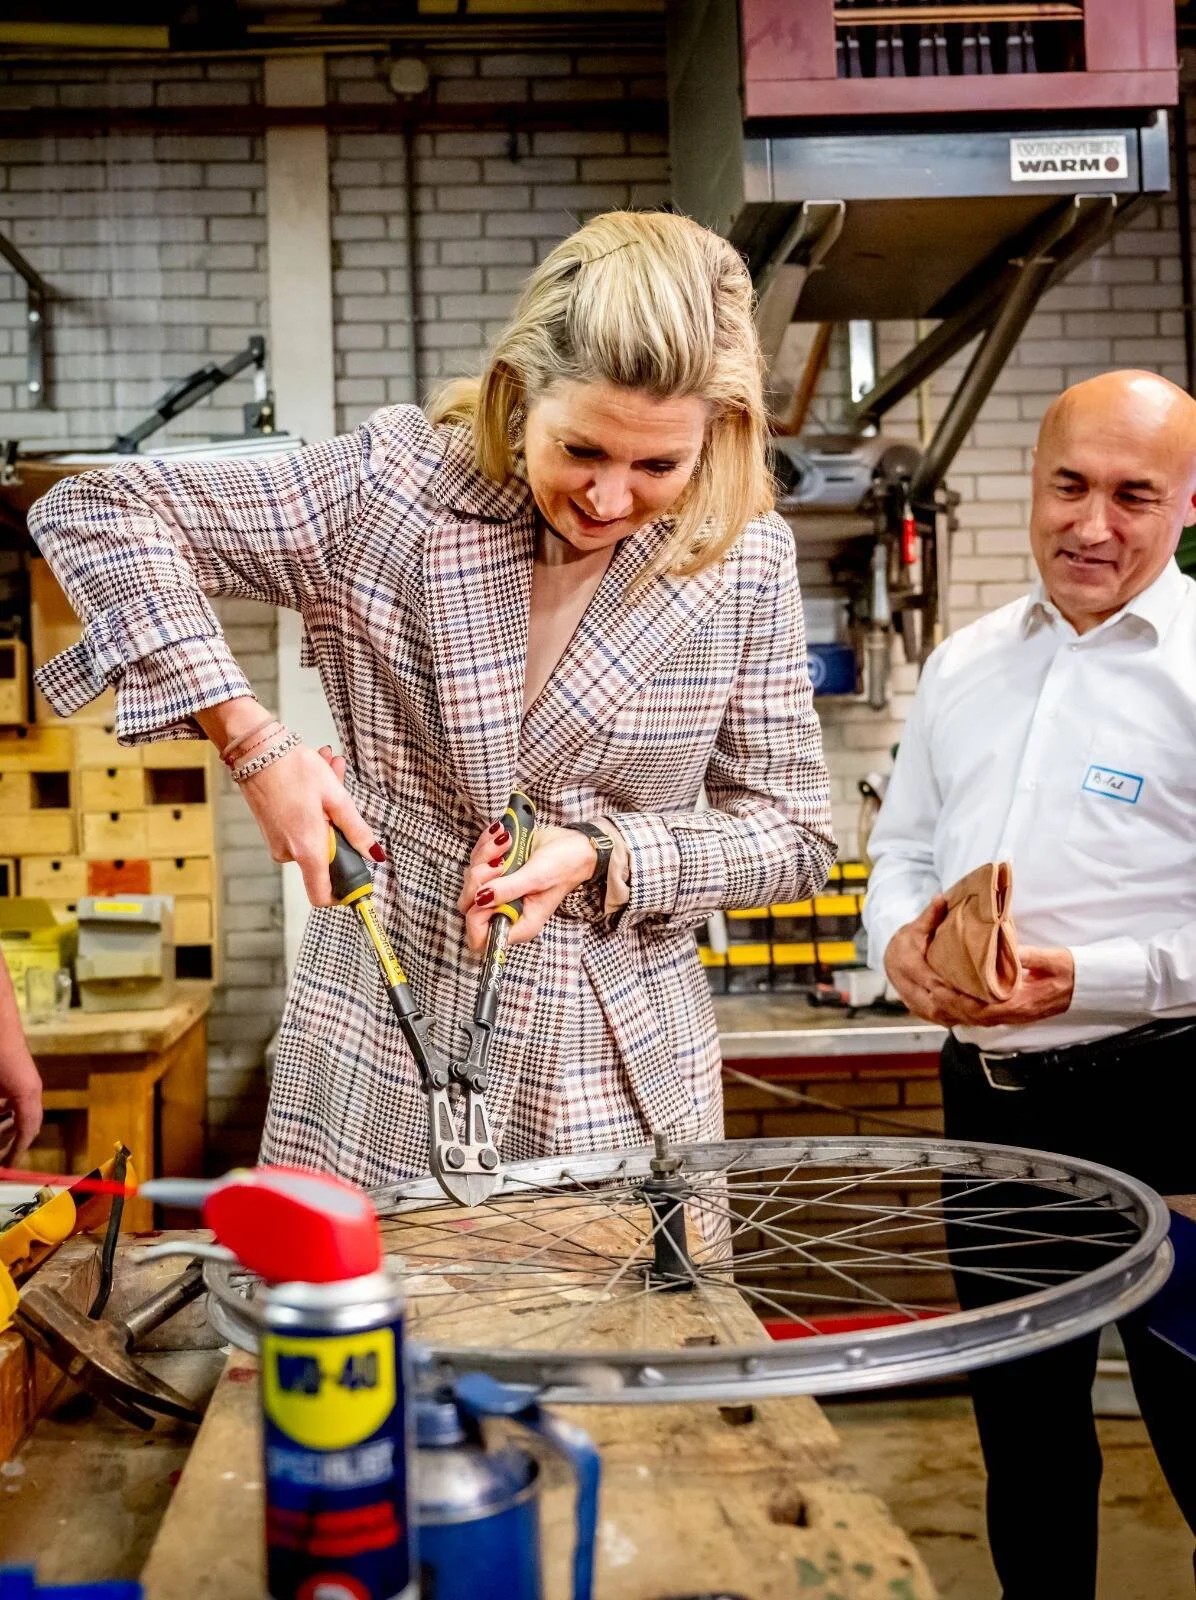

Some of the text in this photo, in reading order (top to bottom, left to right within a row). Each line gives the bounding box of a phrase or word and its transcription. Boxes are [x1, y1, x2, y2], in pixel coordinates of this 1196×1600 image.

[1016, 140, 1121, 157] WINTER
[1018, 158, 1101, 173] WARM
[367, 907, 396, 962] ROUGHNECK
